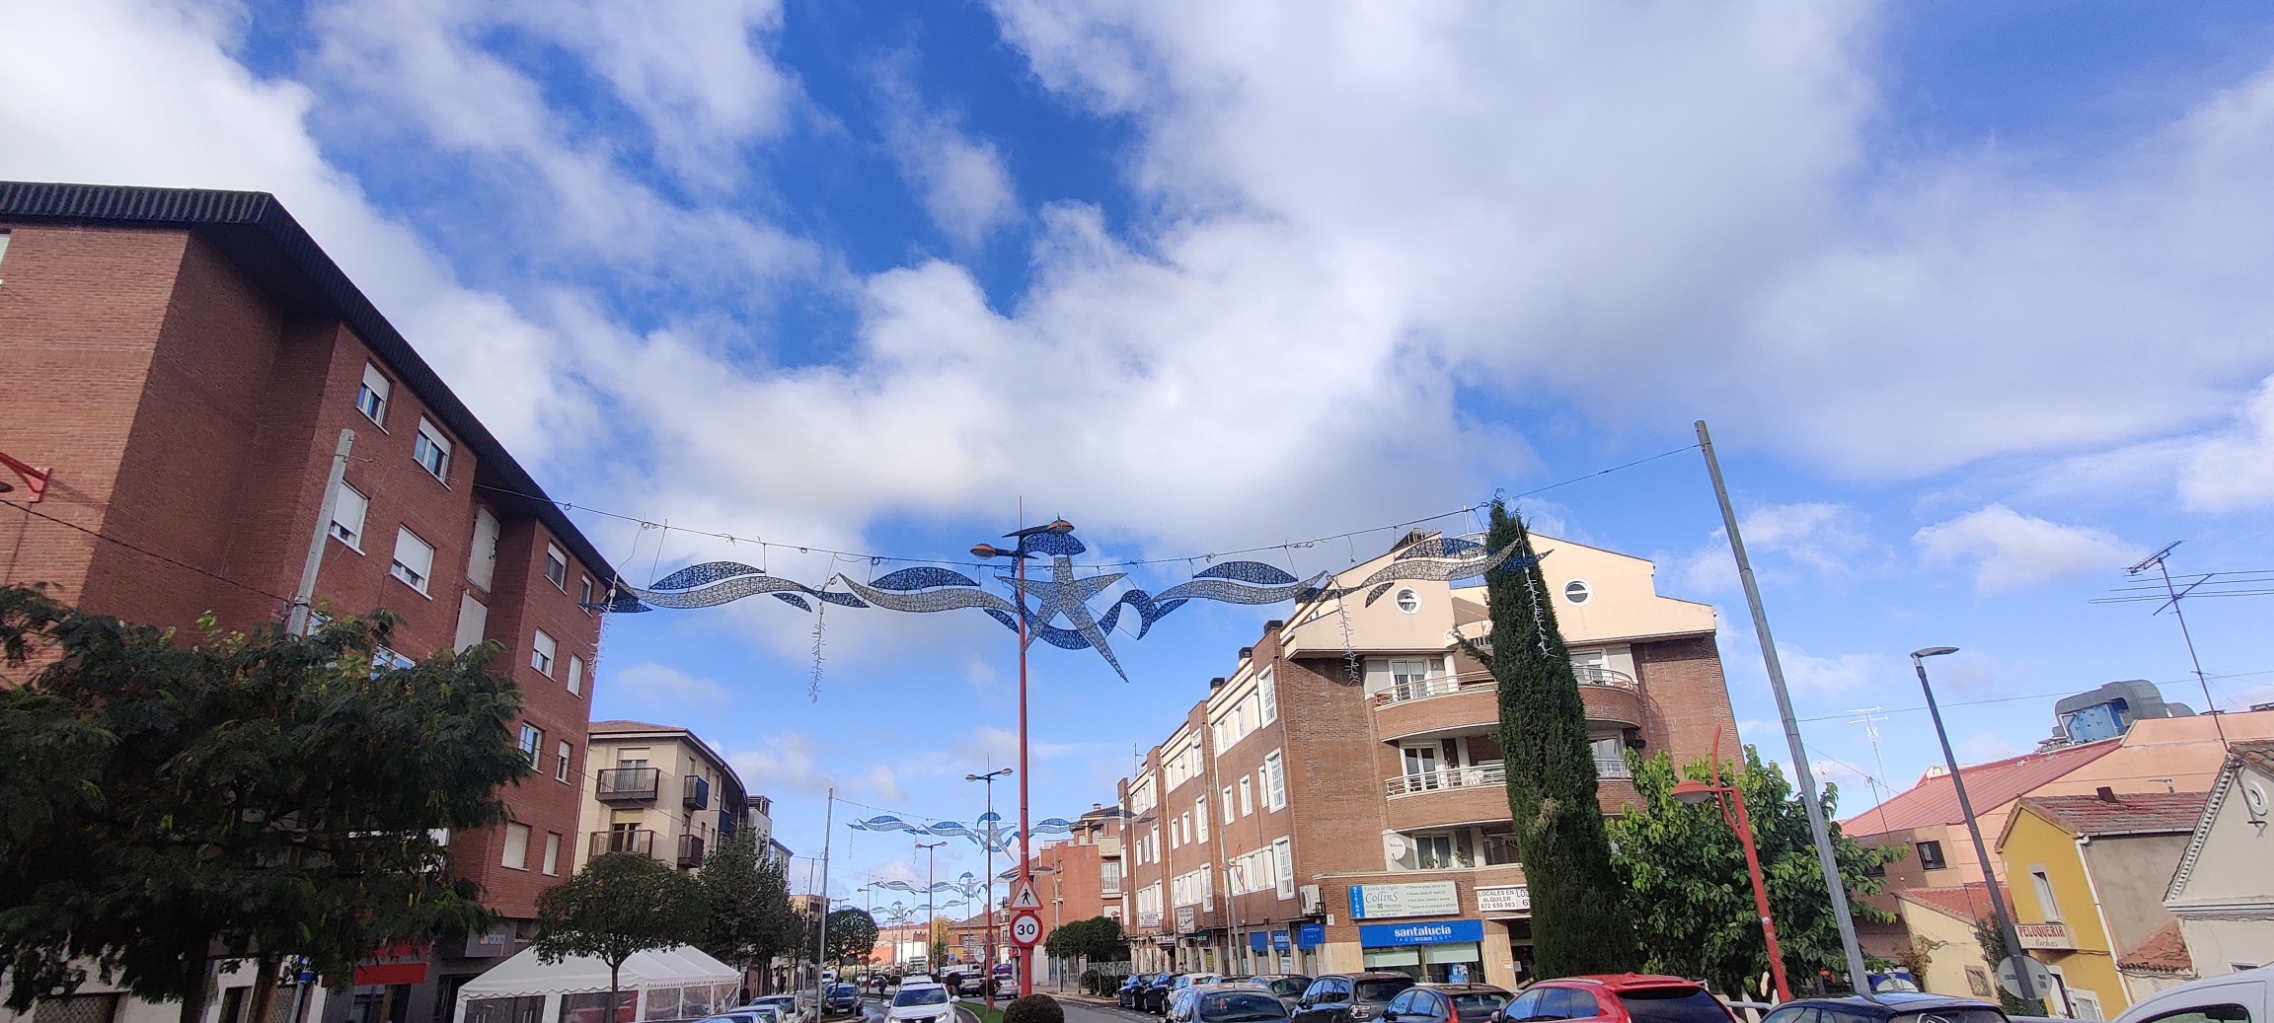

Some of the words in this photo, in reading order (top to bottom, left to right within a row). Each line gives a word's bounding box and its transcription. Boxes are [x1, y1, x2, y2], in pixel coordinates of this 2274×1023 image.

[1018, 924, 1035, 935] 30
[1394, 925, 1451, 937] santalucía
[2017, 926, 2065, 937] PELUQUERIA
[2032, 938, 2058, 947] Mechas
